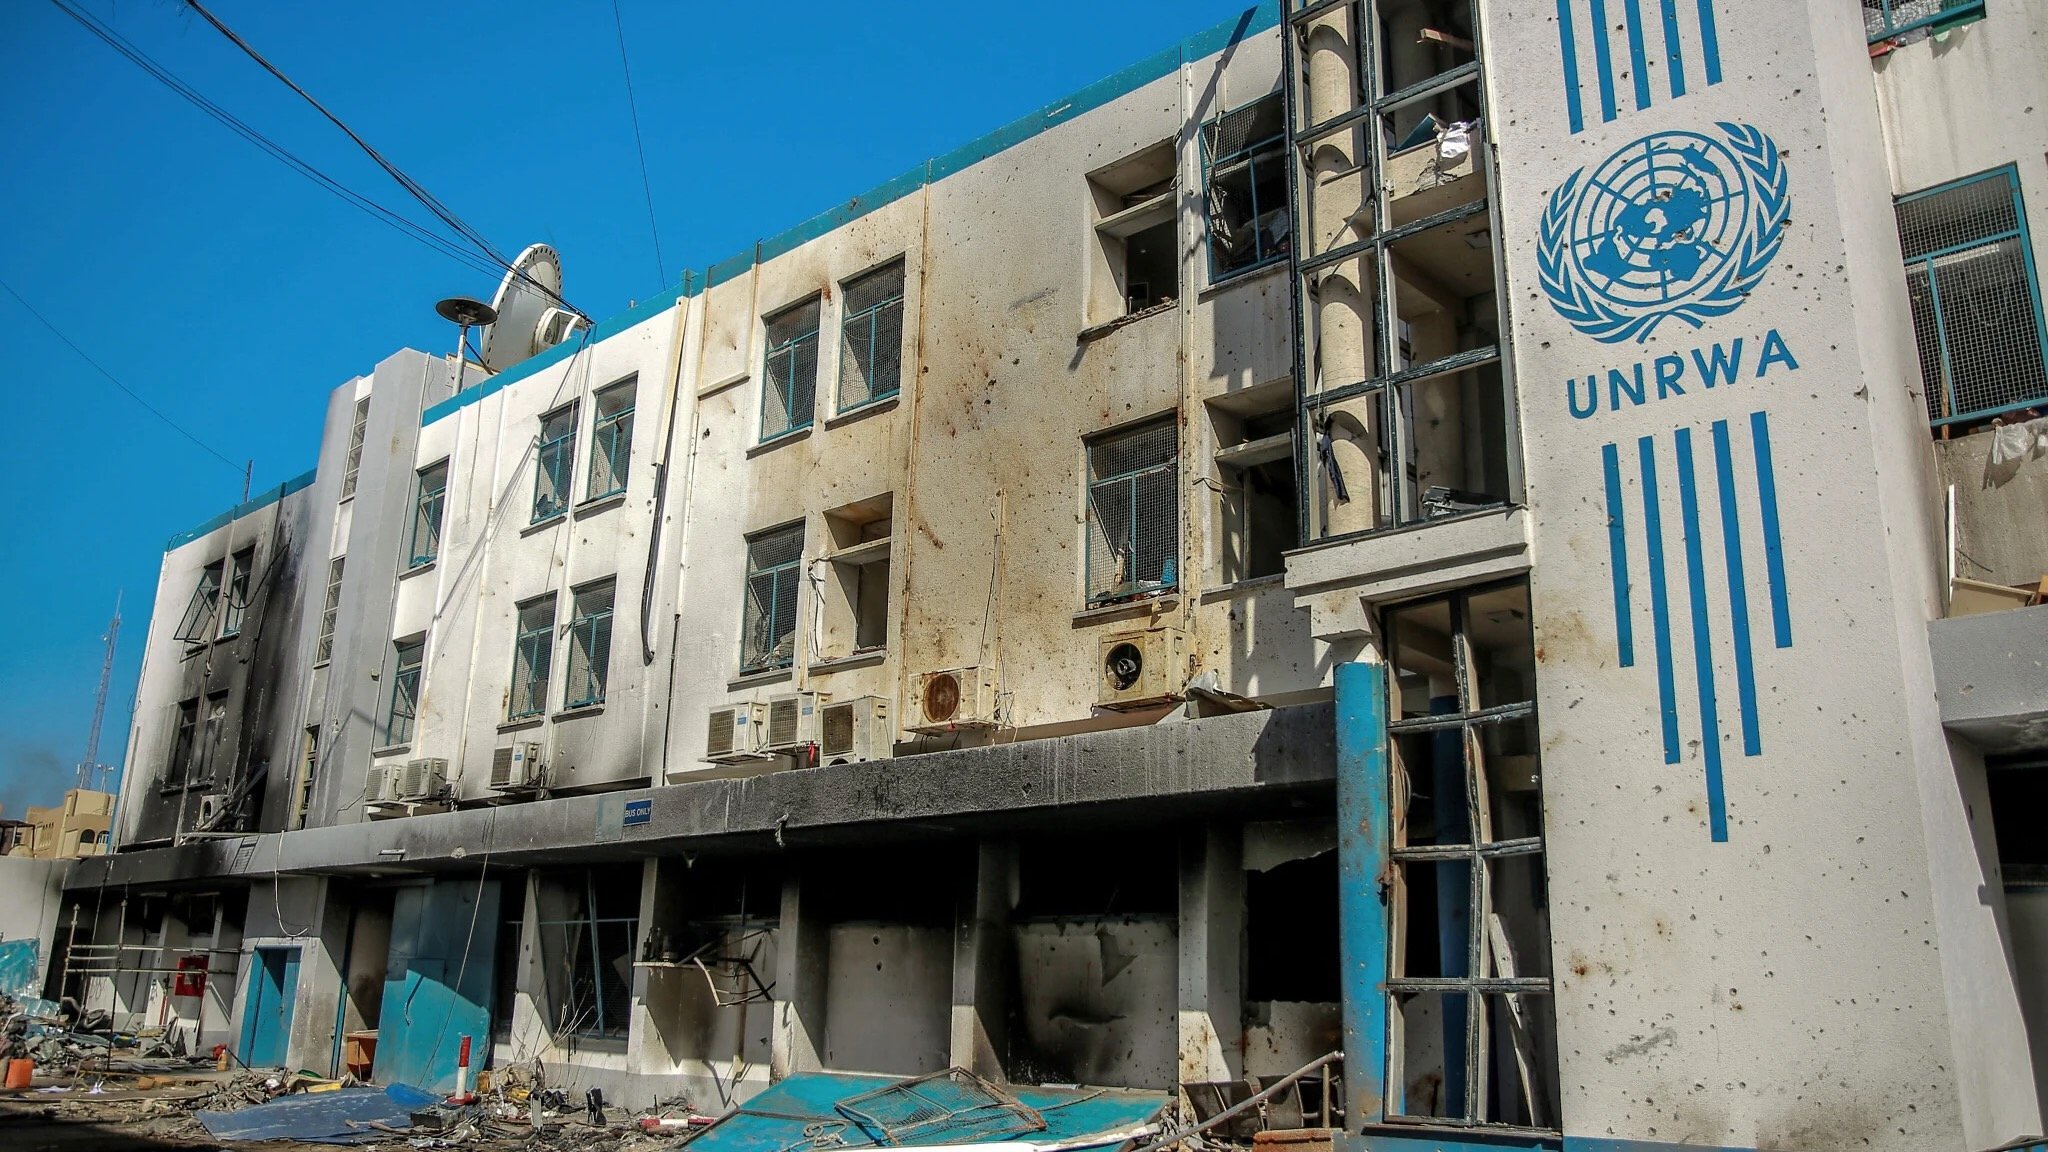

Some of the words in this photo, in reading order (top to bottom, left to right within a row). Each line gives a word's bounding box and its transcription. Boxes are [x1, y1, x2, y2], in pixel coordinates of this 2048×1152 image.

[1567, 328, 1800, 419] UNRWA
[625, 809, 636, 817] BUS
[636, 807, 651, 816] ONLY
